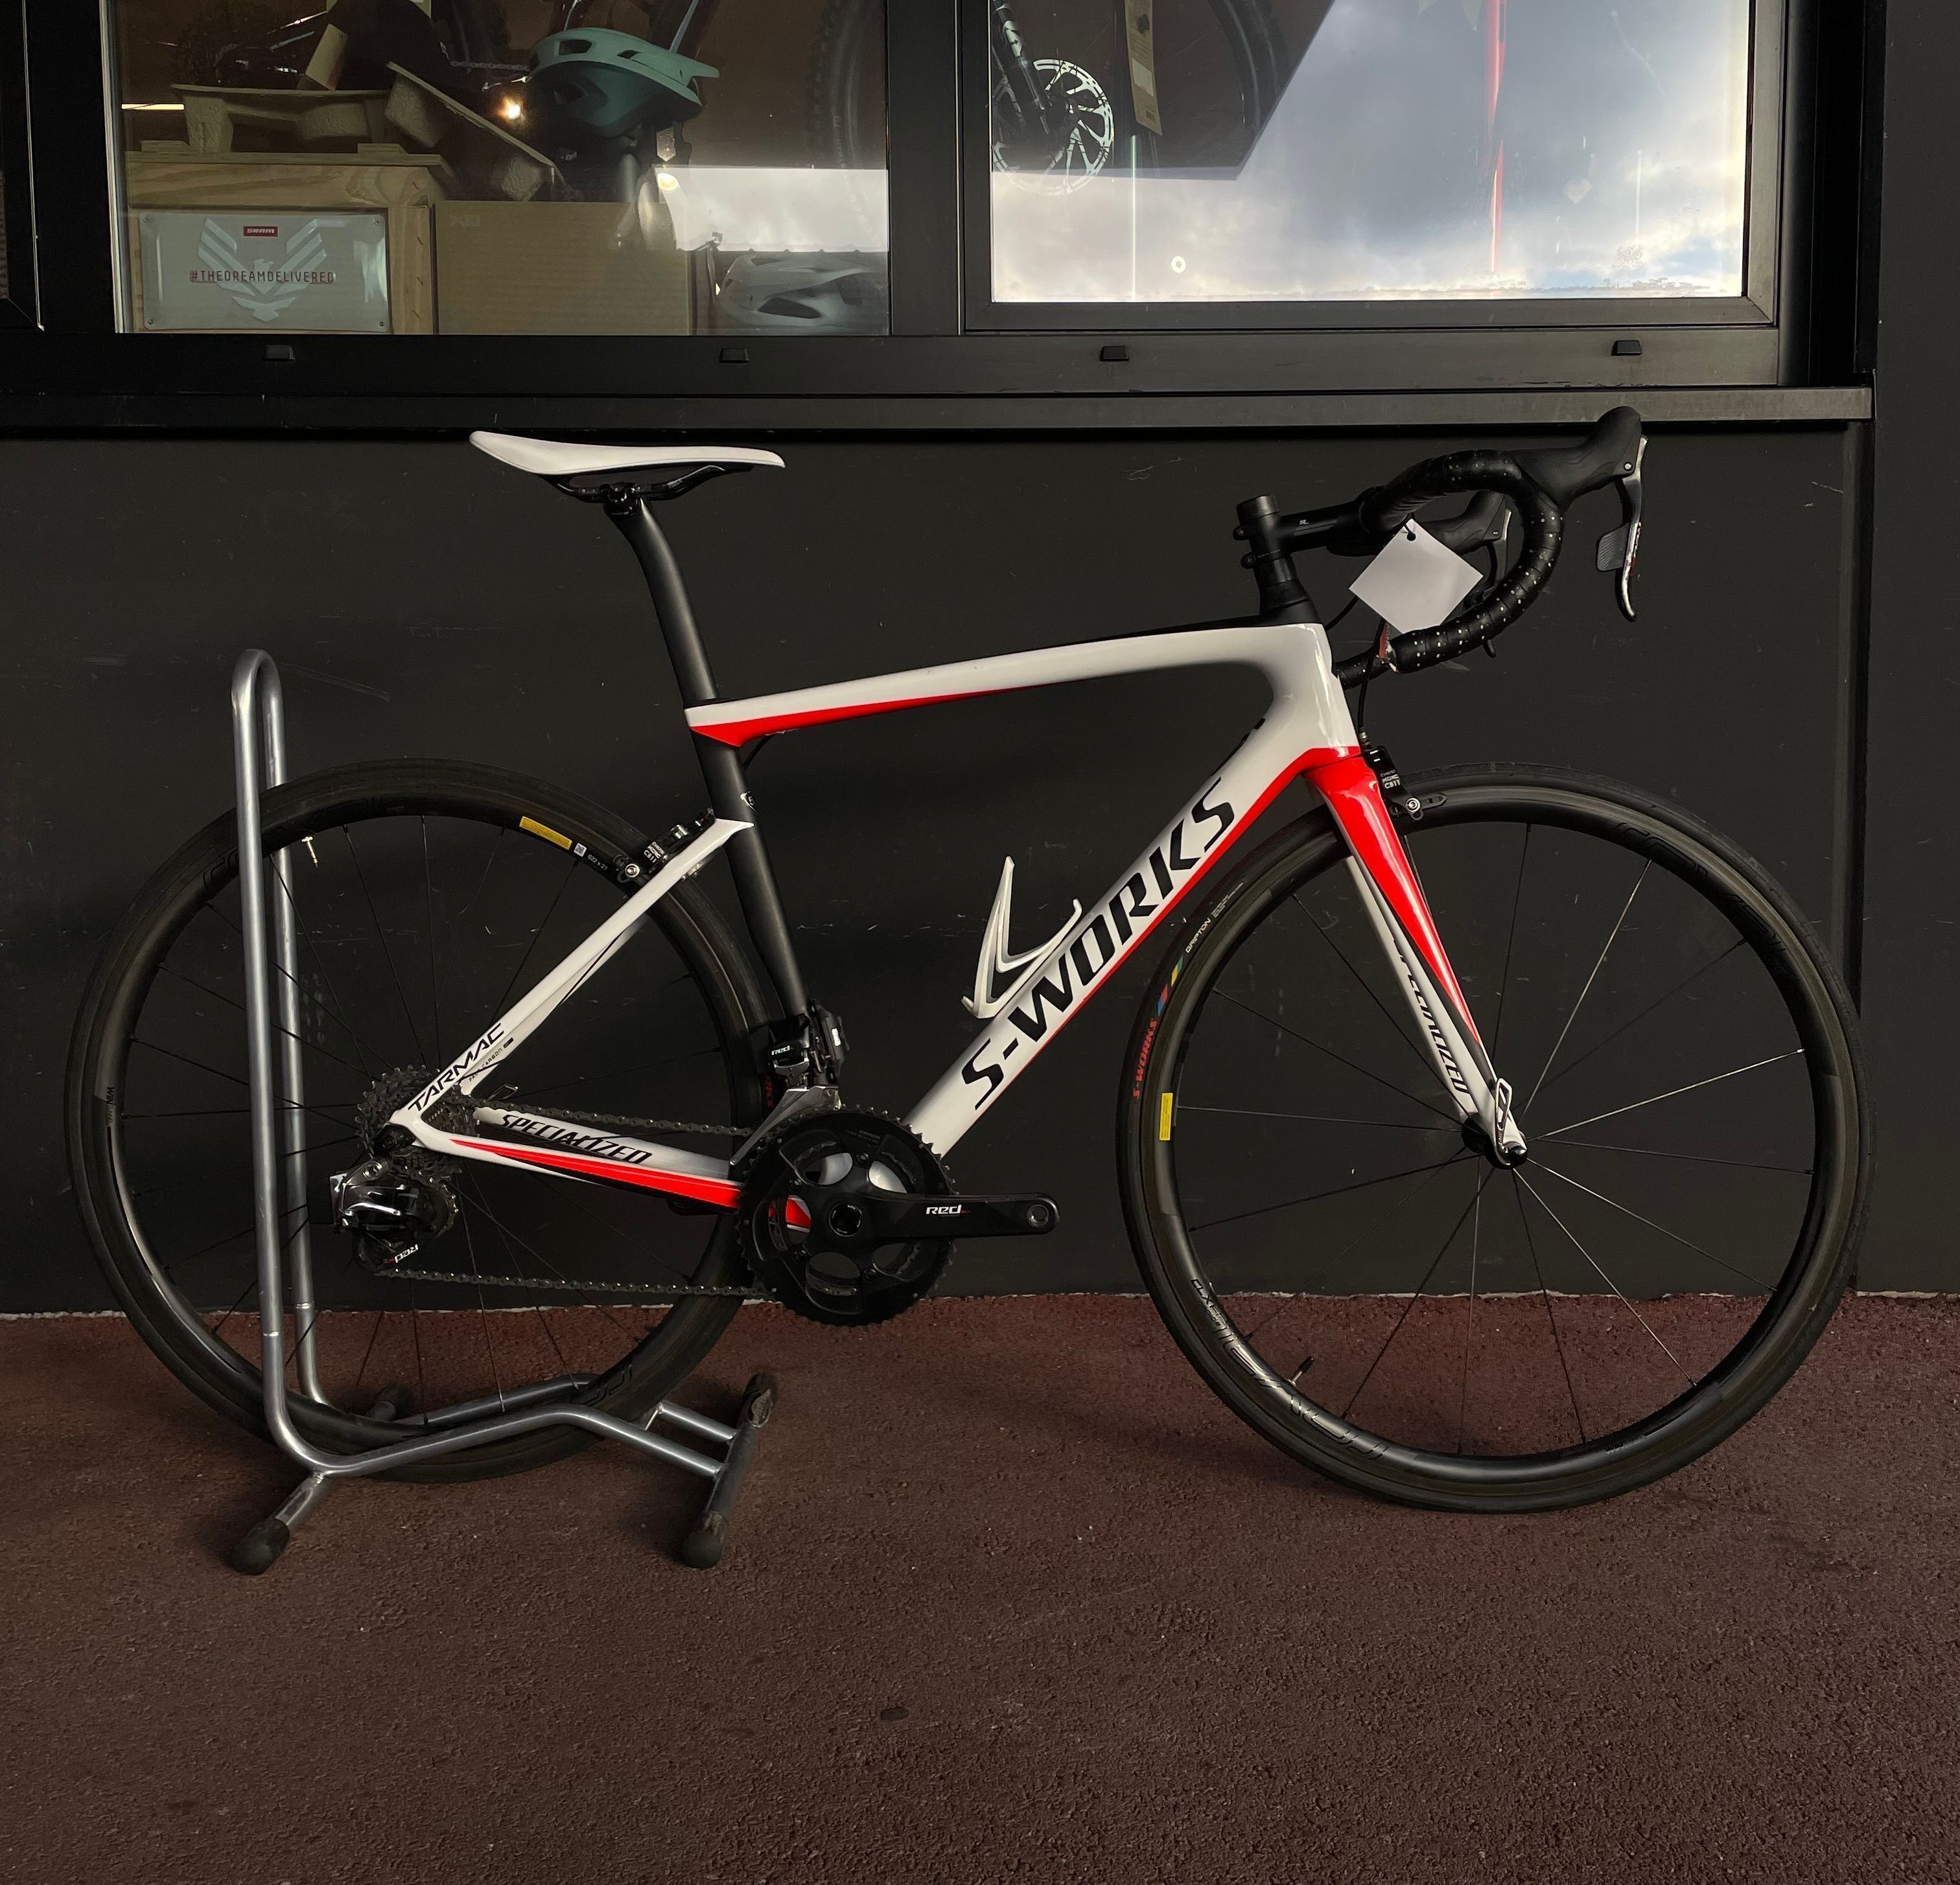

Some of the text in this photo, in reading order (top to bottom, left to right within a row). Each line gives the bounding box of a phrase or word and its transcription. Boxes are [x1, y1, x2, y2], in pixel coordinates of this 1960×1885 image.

[191, 270, 334, 283] #THEDREAMDELIVERED
[962, 778, 1235, 1110] S-WORKS
[408, 1023, 504, 1111] TARMAC
[1132, 1018, 1158, 1100] S-WORKS
